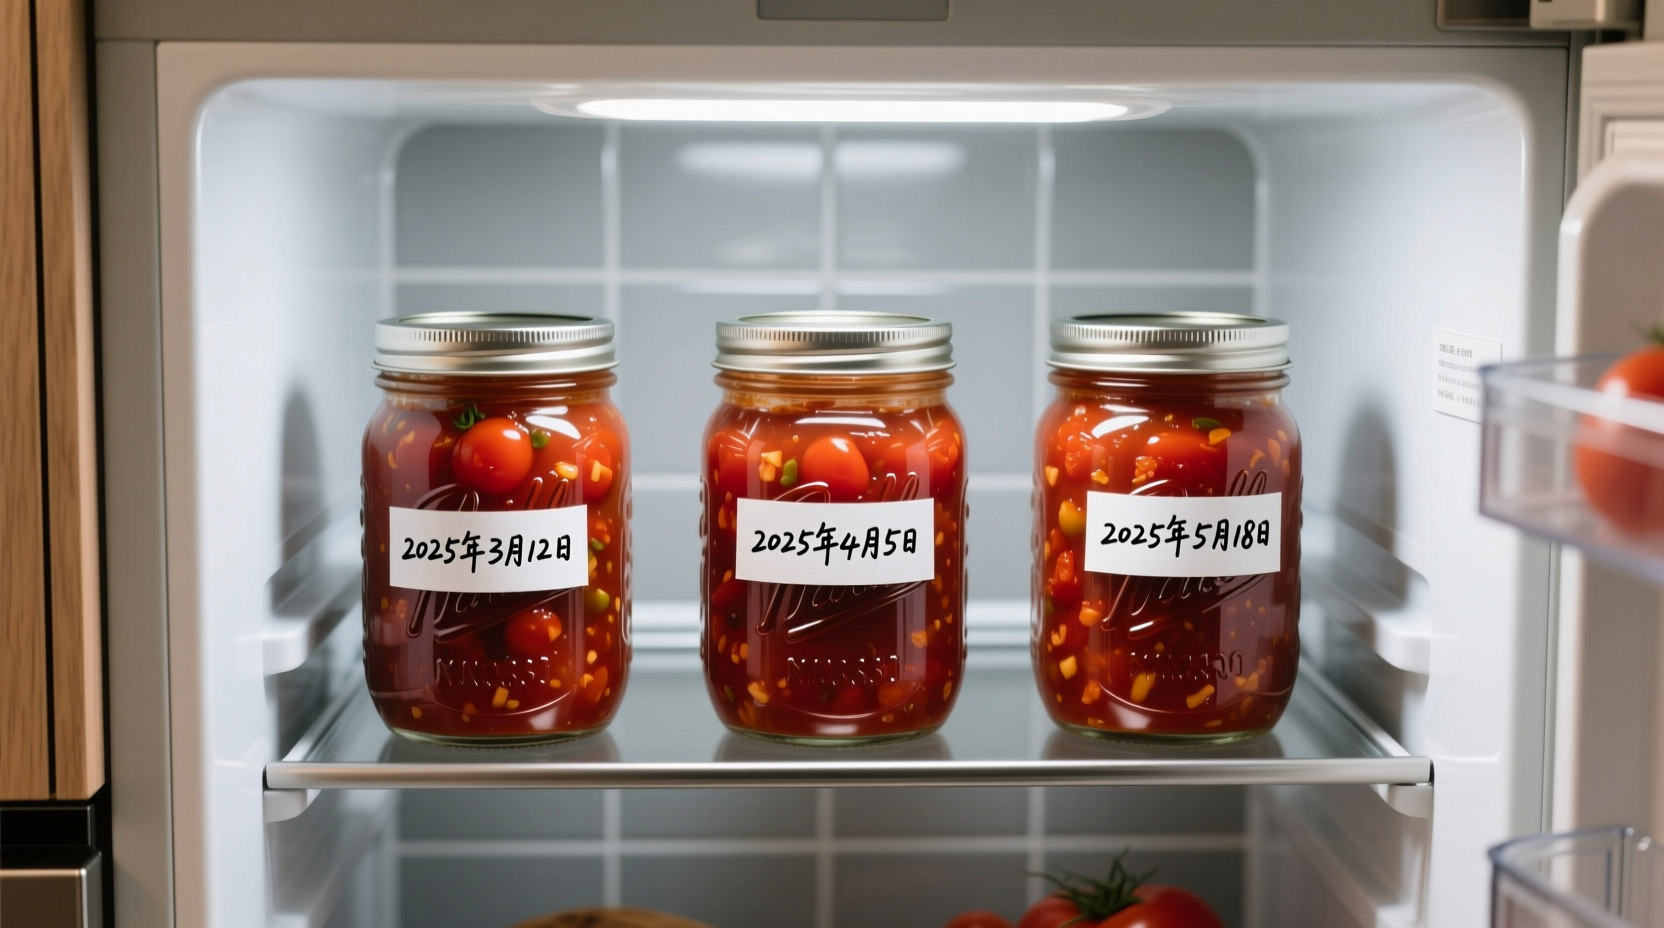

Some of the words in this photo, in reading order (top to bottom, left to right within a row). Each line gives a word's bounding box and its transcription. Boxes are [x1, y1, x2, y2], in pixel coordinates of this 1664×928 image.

[402, 531, 570, 573] 2025年3月12日
[752, 522, 916, 566] 2025年4月5日
[1101, 515, 1269, 558] 2025年5月18日
